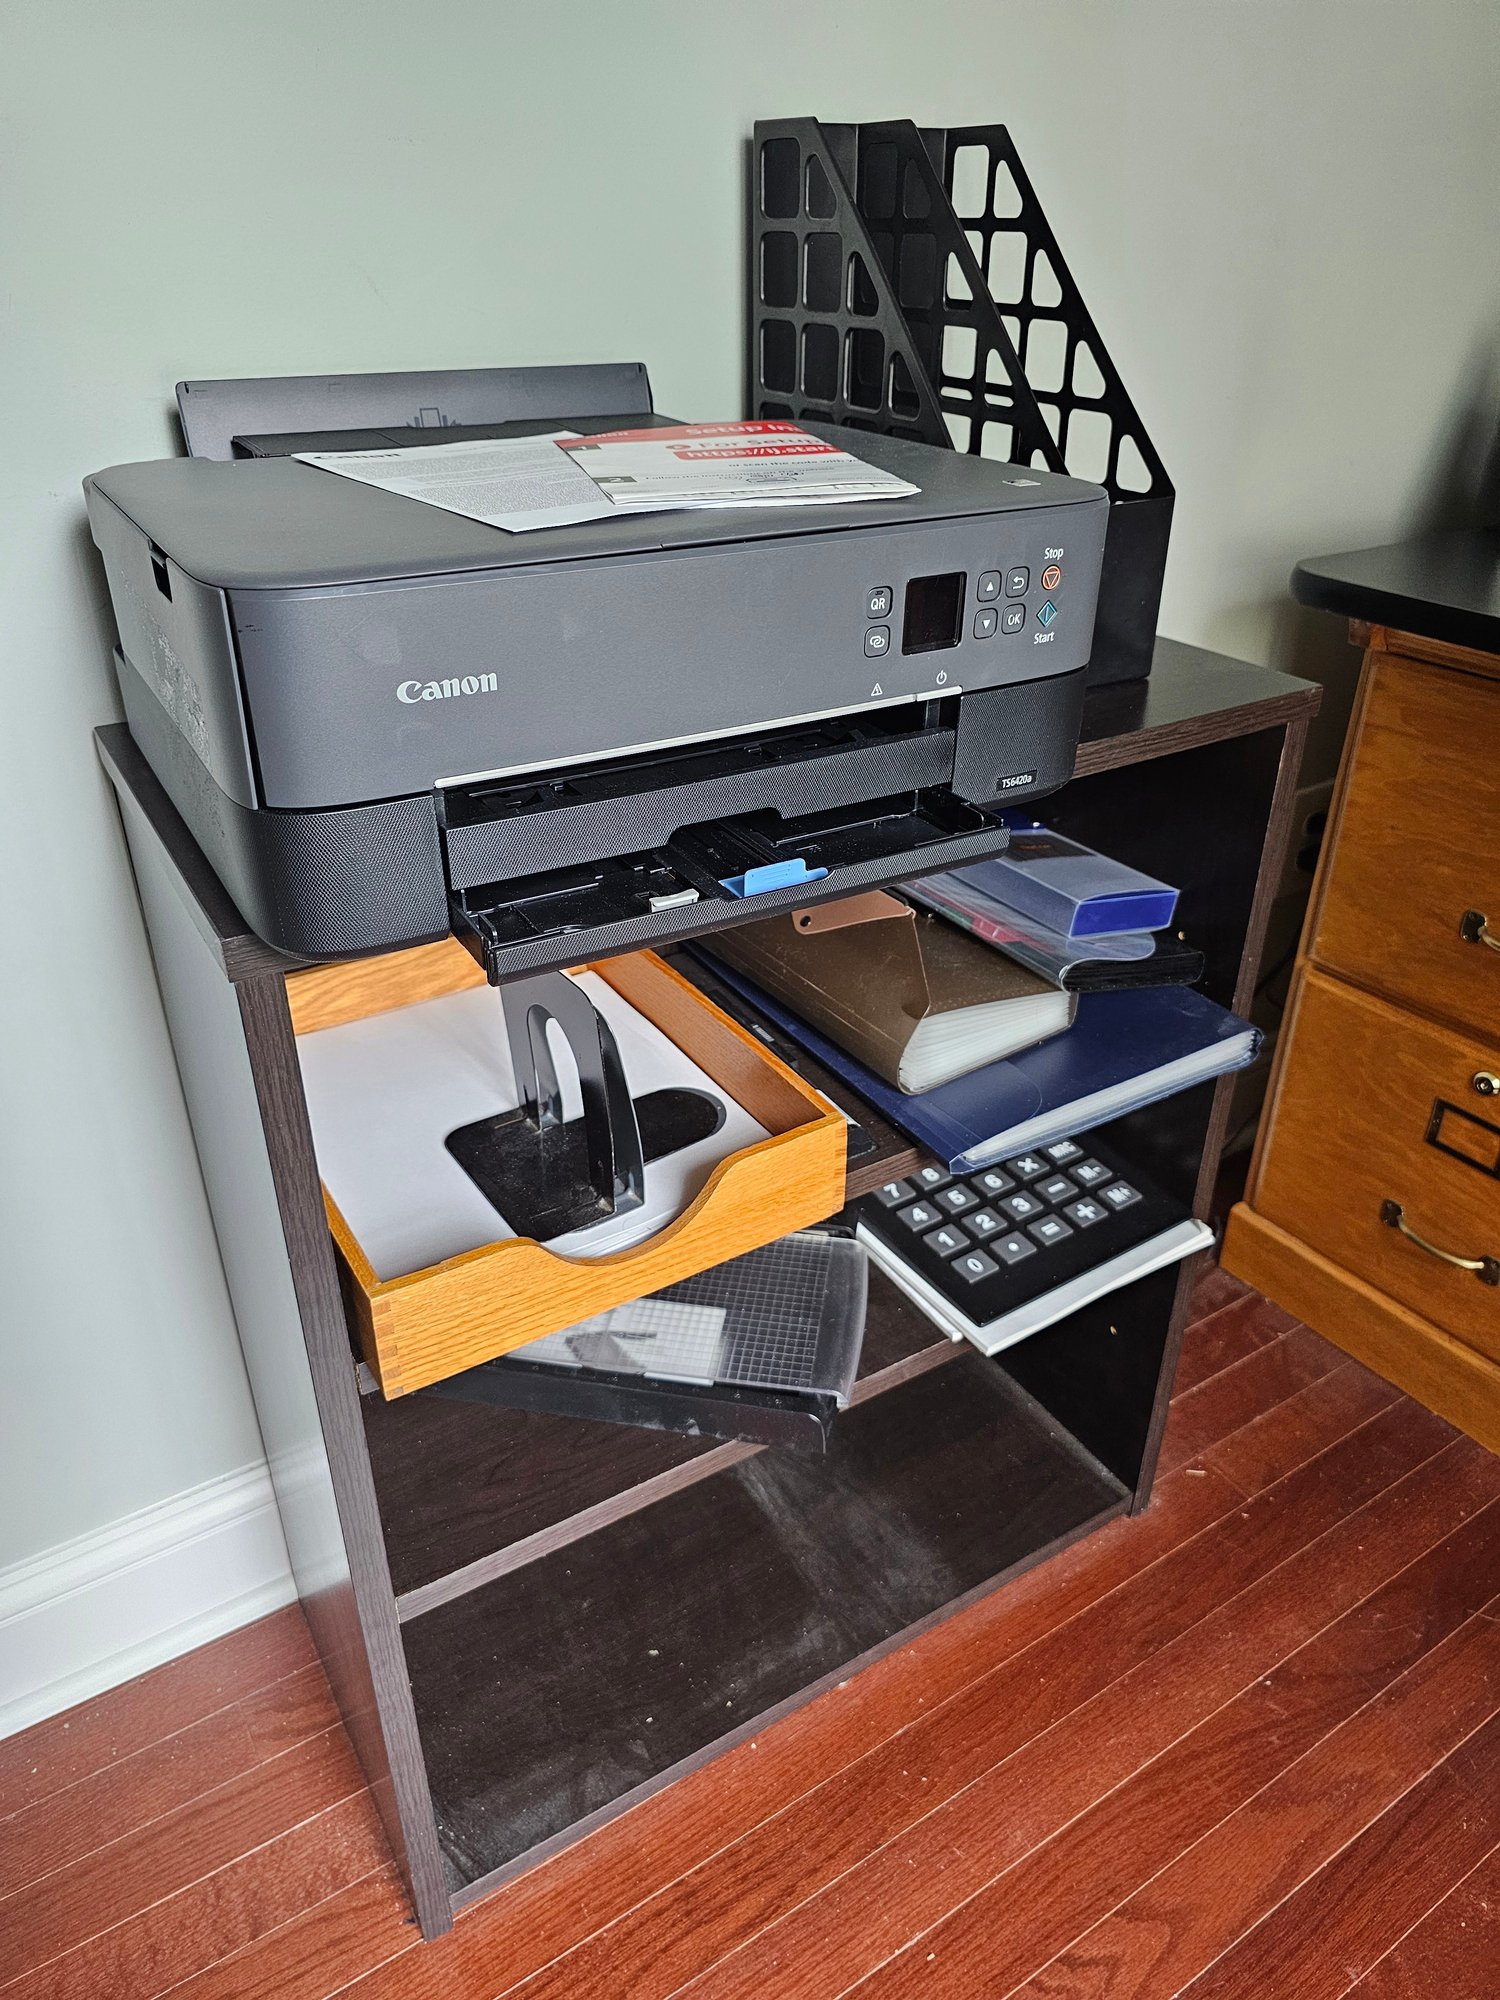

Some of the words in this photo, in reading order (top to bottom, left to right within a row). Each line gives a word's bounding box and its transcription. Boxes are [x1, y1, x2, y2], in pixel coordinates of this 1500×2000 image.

[686, 424, 762, 435] Setup
[699, 440, 738, 448] For
[1044, 547, 1065, 561] Stop
[870, 596, 887, 611] QR
[1007, 612, 1022, 626] OK
[1033, 631, 1055, 645] Start
[396, 672, 498, 704] Canon
[1002, 774, 1032, 788] TS6420a
[921, 1167, 940, 1182] 8
[984, 1174, 1003, 1189] 6
[883, 1183, 900, 1198] 7
[947, 1190, 967, 1205] 5
[1011, 1197, 1032, 1212] 3
[912, 1207, 929, 1222] 4
[975, 1214, 996, 1230] 2
[937, 1231, 956, 1248] 1
[966, 1257, 984, 1273] 0
